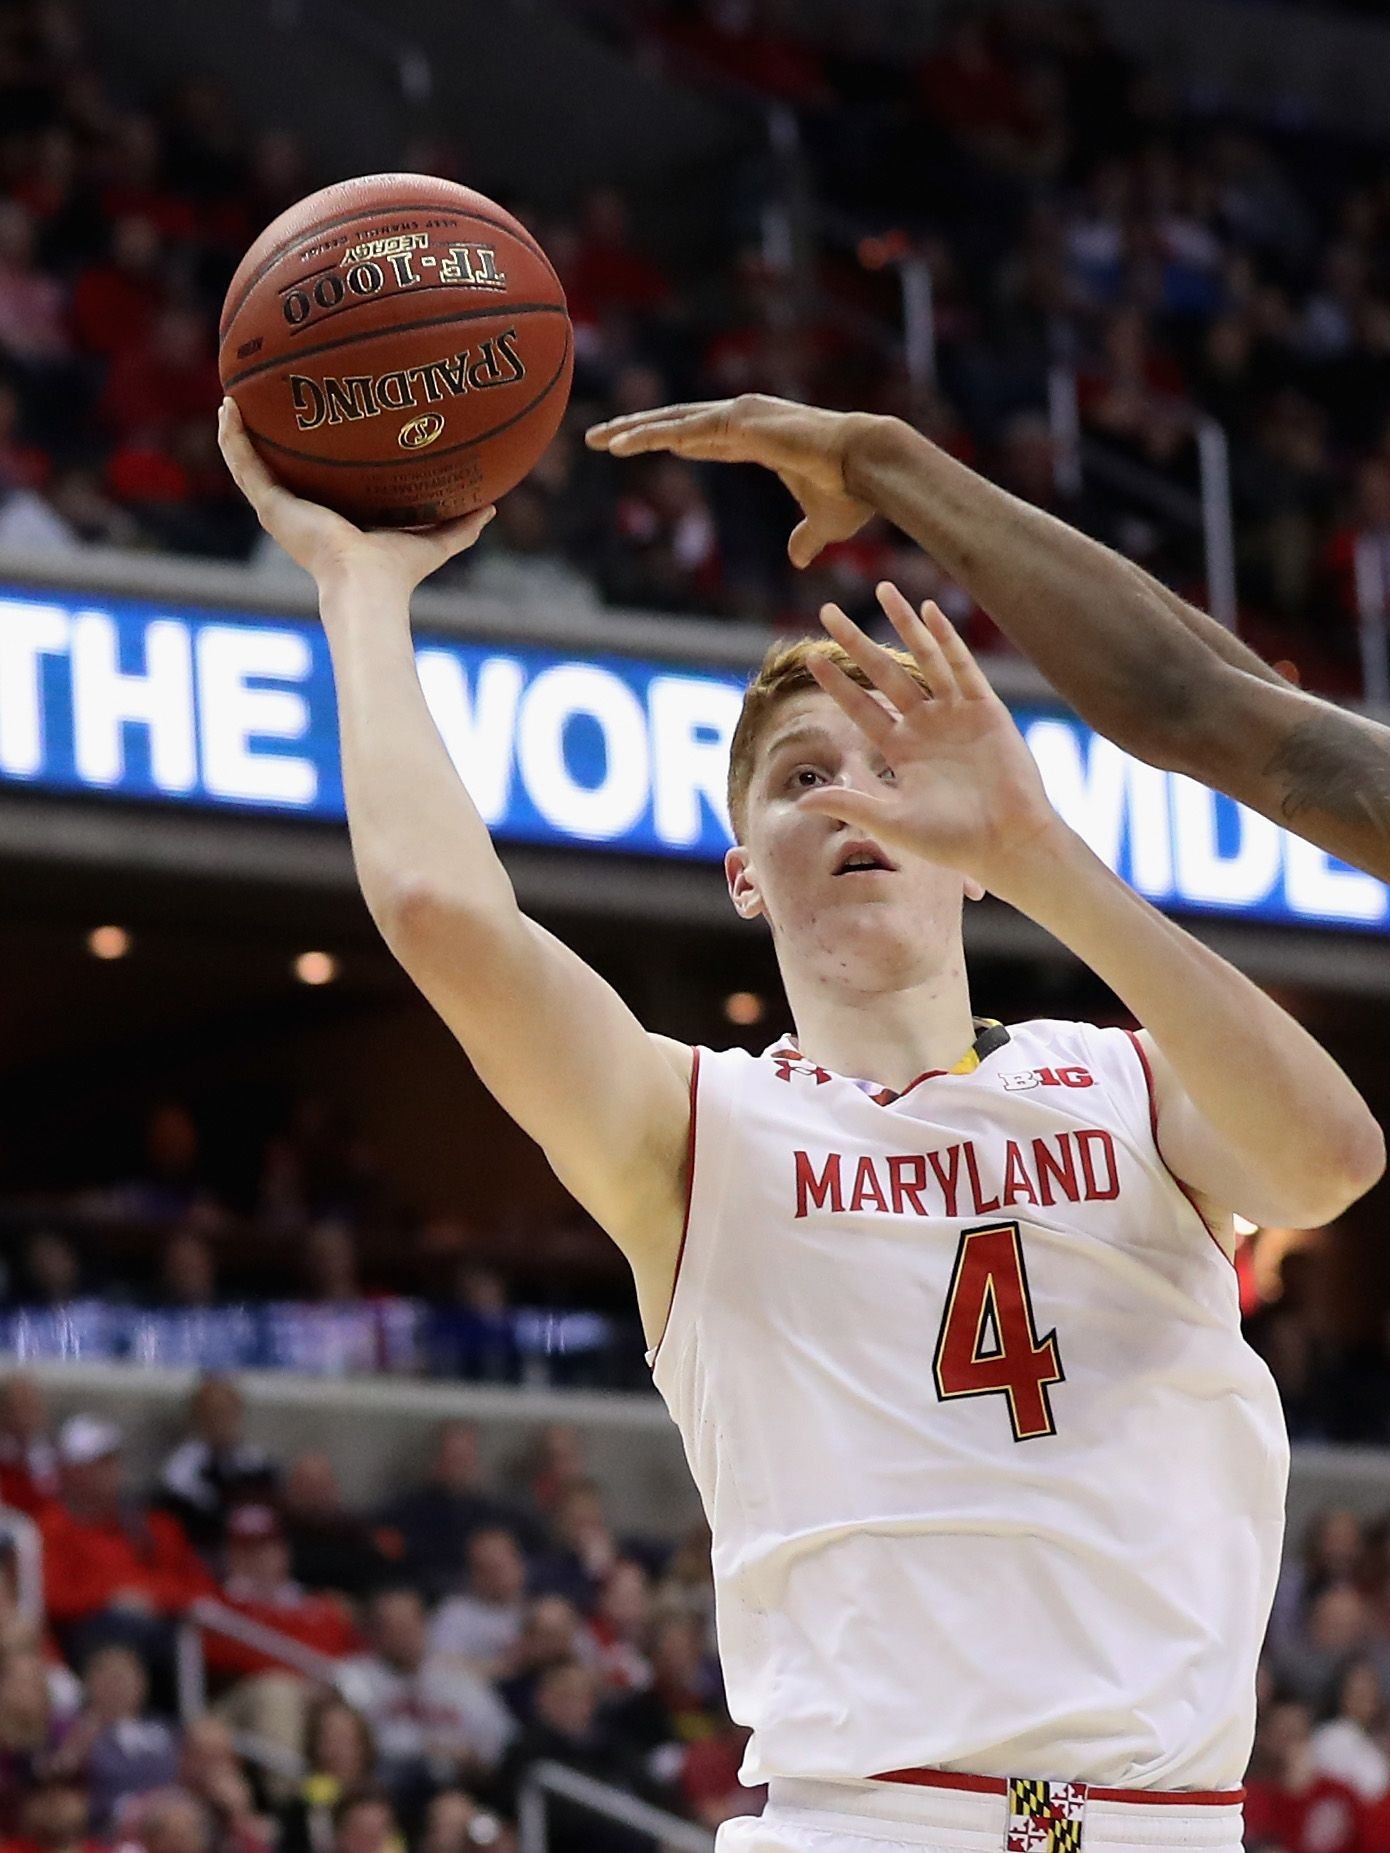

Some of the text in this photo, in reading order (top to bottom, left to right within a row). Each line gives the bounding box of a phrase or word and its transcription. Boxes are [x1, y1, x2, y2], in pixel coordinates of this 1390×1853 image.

[281, 247, 507, 327] TF-1000
[340, 232, 429, 268] LEGACY
[289, 327, 526, 431] SPALDING
[0, 598, 316, 807] THE
[794, 1130, 1121, 1219] MARYLAND
[932, 1221, 1066, 1443] 4
